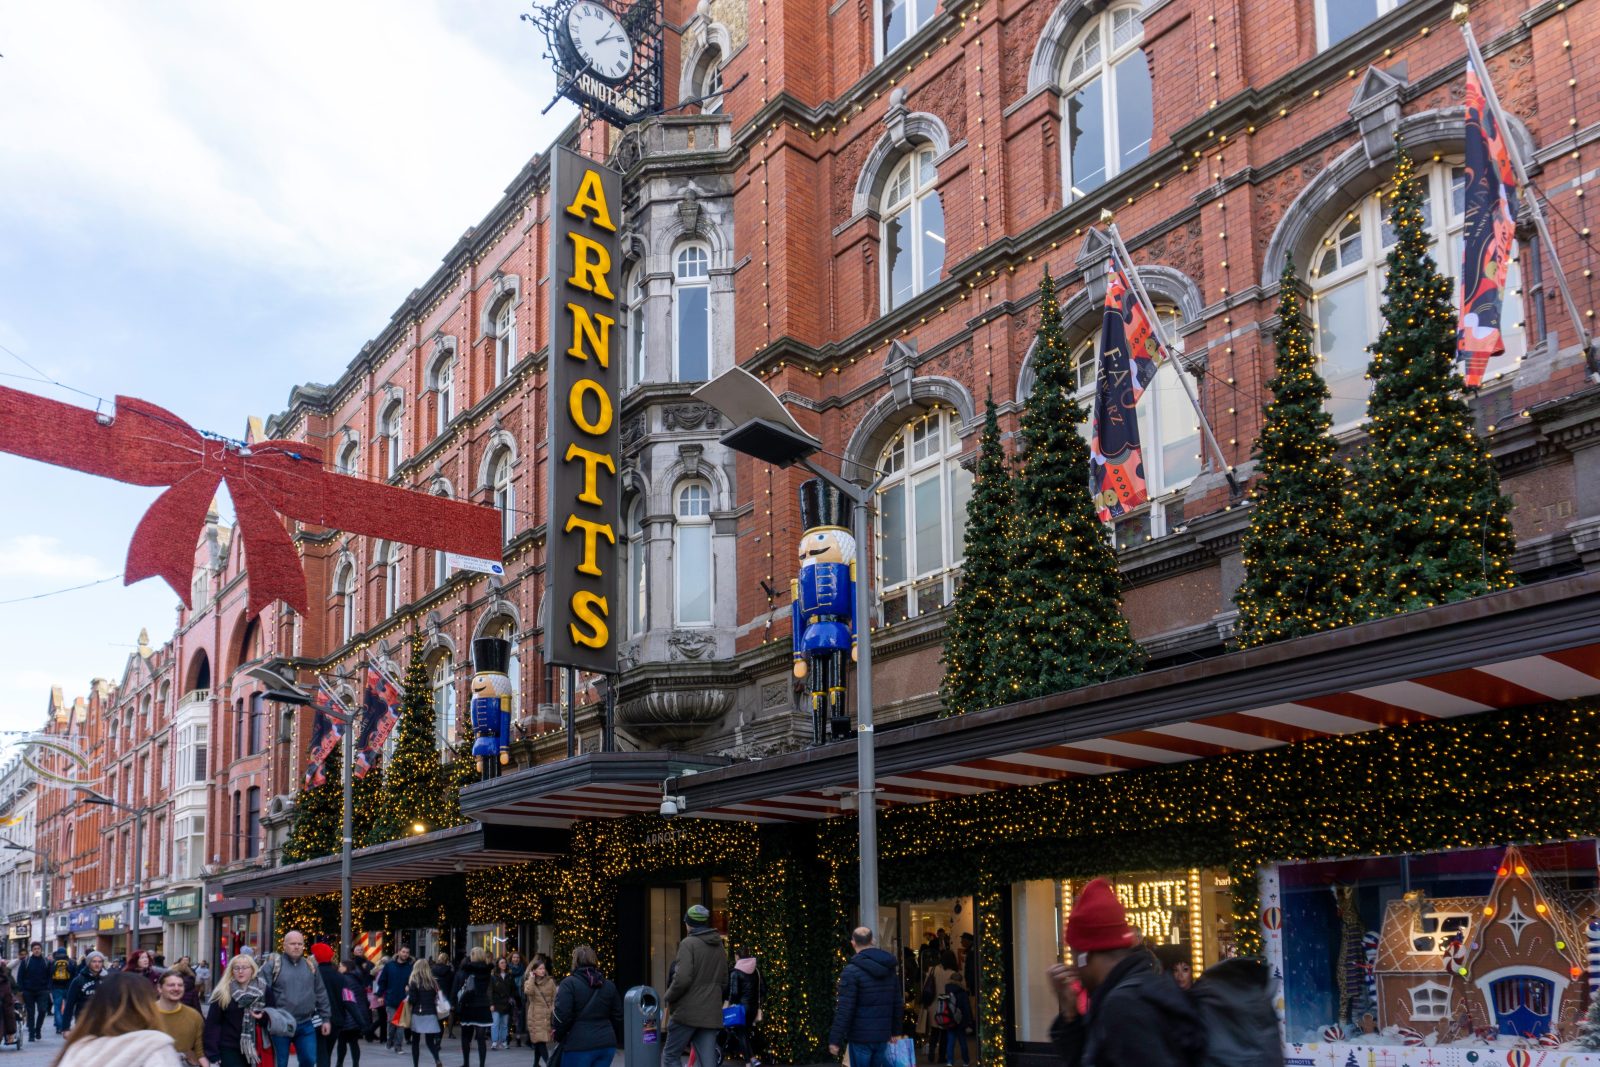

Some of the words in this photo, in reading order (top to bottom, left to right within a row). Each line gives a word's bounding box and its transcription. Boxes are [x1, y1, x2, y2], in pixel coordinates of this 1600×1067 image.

[566, 171, 615, 647] ARNOTTS
[372, 722, 390, 748] DUBLIN
[646, 829, 687, 846] ARNOTTS
[1109, 880, 1187, 909] RLOTTE
